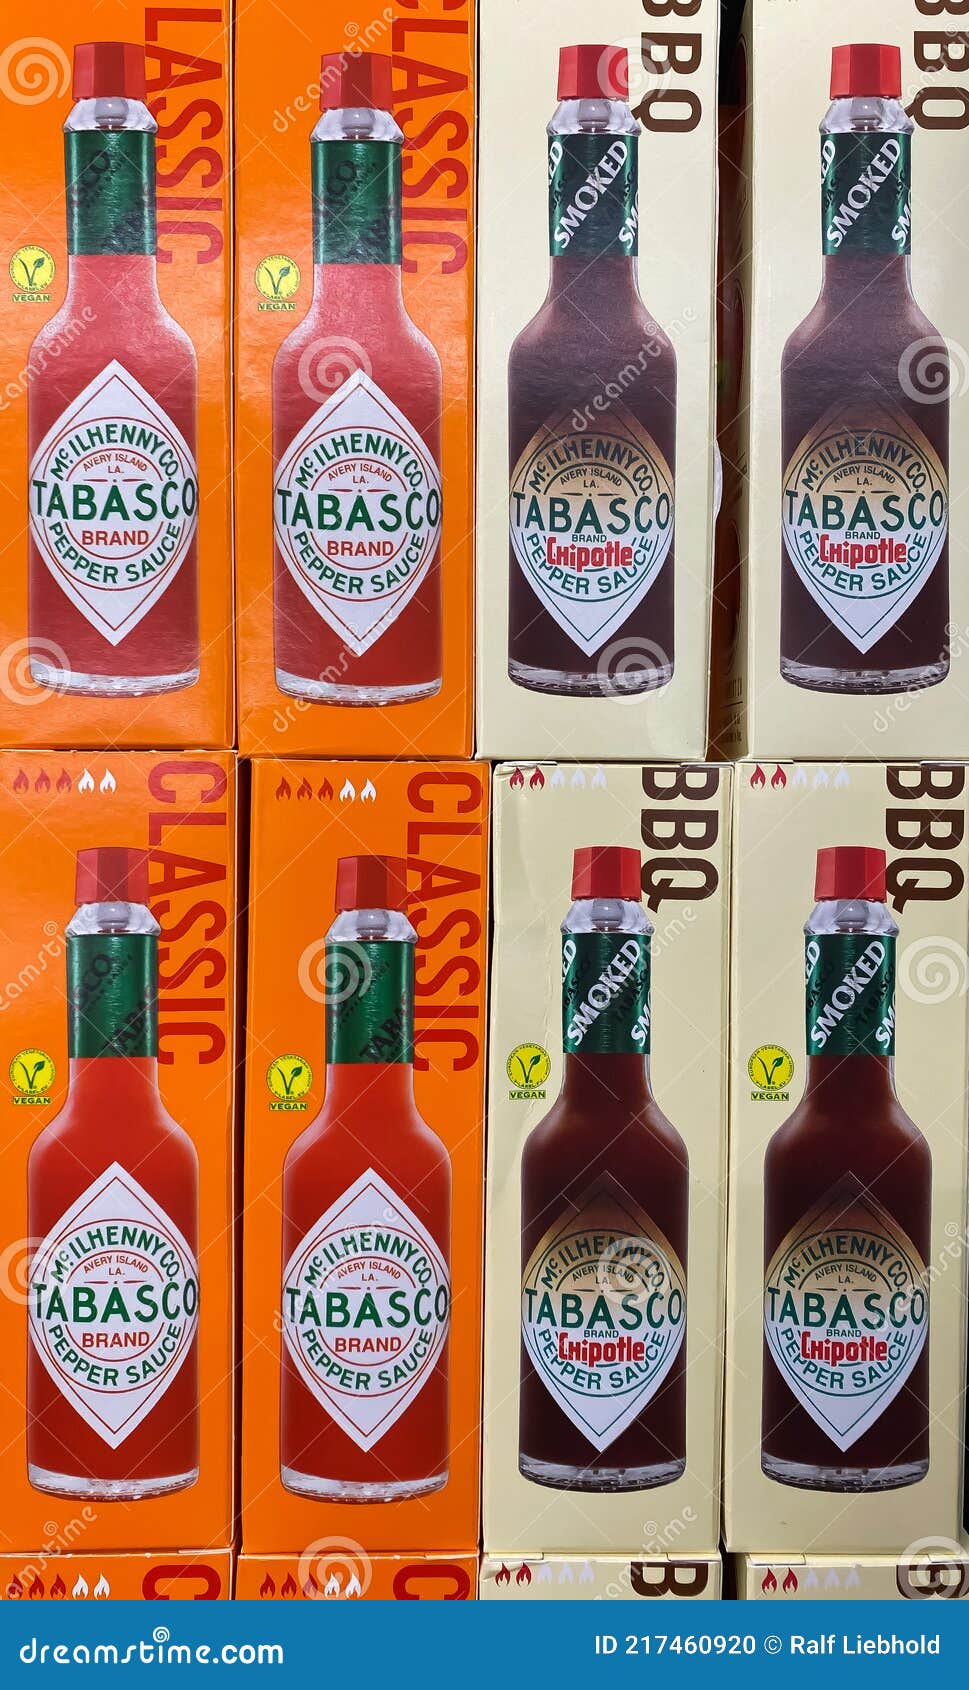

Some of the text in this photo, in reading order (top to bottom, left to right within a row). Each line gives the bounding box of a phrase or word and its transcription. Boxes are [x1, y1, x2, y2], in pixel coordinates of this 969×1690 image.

[391, 0, 469, 275] LASSIC
[554, 140, 628, 249] SMOKED
[826, 139, 901, 248] SMOKED
[13, 294, 51, 302] VEGAN
[258, 302, 296, 311] VEGAN
[82, 454, 148, 472] AVERY ISLAND
[107, 465, 124, 474] LA.
[327, 463, 393, 482] AVERY ISLAND
[352, 475, 369, 484] LA.
[559, 468, 622, 487] AVERY ISLAND
[583, 480, 600, 489] LA.
[833, 466, 896, 485] AVERY ISLAND
[856, 477, 873, 486] LA.
[32, 477, 196, 521] TABASCO
[277, 488, 440, 532] TABASCO
[512, 492, 670, 534] TABASCO
[785, 489, 944, 532] TABASCO
[81, 530, 149, 546] BRAND
[571, 534, 607, 543] BRAND
[845, 531, 880, 540] BRAND
[48, 522, 180, 584] PEPPER SAUCE
[327, 541, 394, 557] BRAND
[294, 532, 425, 594] PEPPER SAUCE
[640, 766, 720, 913] BBQ
[885, 765, 966, 915] BBQ
[148, 760, 228, 1065] CLASSIC
[407, 771, 483, 1072] CLASSIC
[567, 939, 640, 1046] SMOKED
[810, 941, 886, 1049] SMOKED
[510, 1090, 546, 1099] VEGAN
[751, 1092, 789, 1100] VEGAN
[270, 1102, 308, 1110] VEGAN
[83, 1255, 149, 1274] AVERY ISLAND
[108, 1267, 125, 1276] LA.
[337, 1261, 402, 1280] AVERY ISLAND
[572, 1264, 635, 1284] AVERY ISLAND
[814, 1264, 878, 1283] AVERY ISLAND
[361, 1274, 379, 1282] LA.
[595, 1276, 611, 1285] LA.
[838, 1275, 854, 1284] LA.
[31, 1278, 197, 1324] TABASCO
[285, 1284, 448, 1328] TABASCO
[525, 1288, 683, 1332] TABASCO
[767, 1286, 925, 1330] TABASCO
[82, 1331, 150, 1348] BRAND
[584, 1330, 619, 1339] BRAND
[826, 1328, 862, 1338] BRAND
[335, 1337, 402, 1353] BRAND
[48, 1323, 182, 1387] PEPPER SAUCE
[301, 1329, 433, 1391] PEPPER SAUCE
